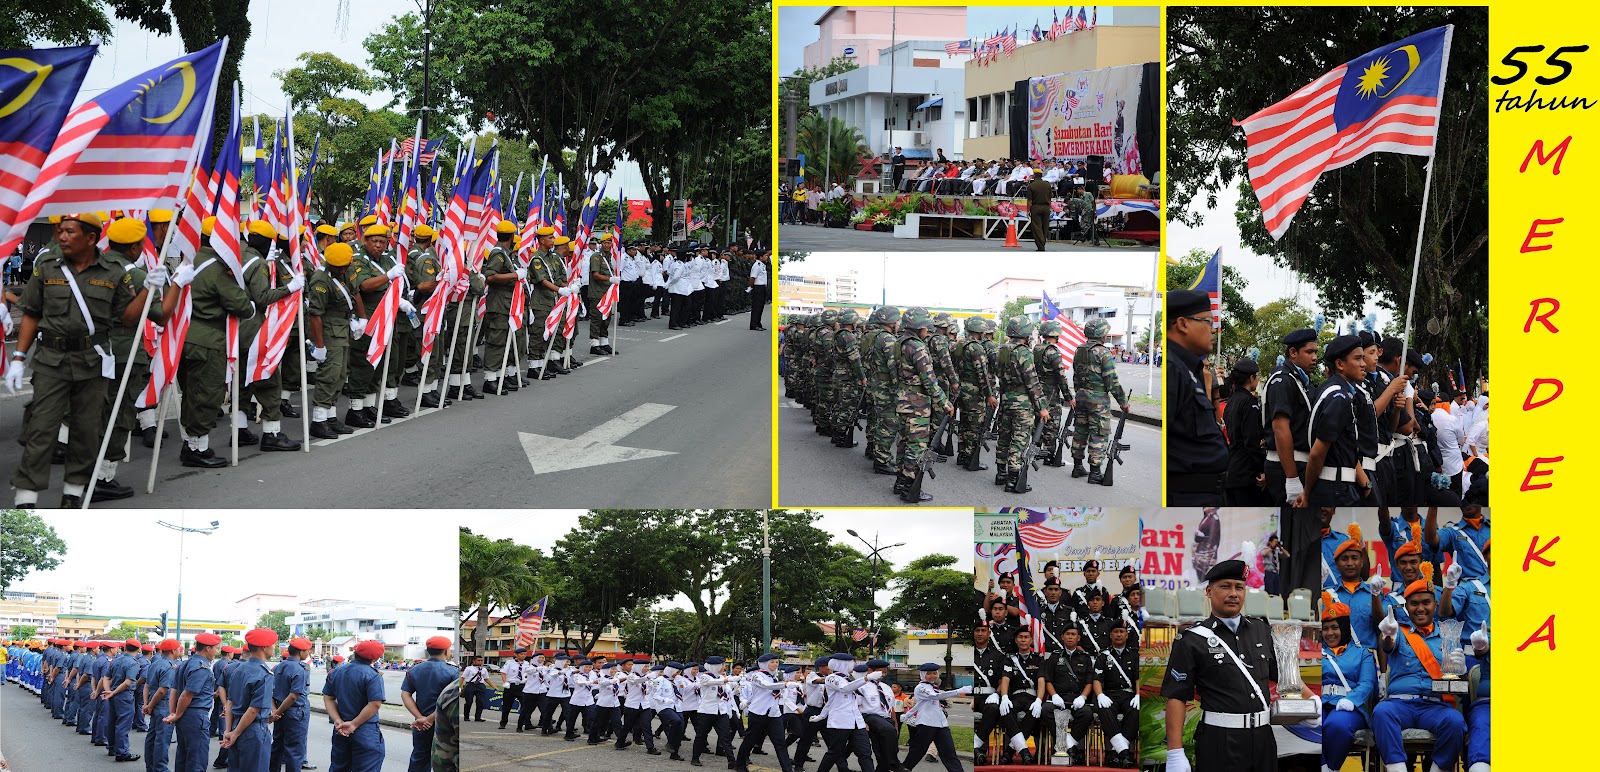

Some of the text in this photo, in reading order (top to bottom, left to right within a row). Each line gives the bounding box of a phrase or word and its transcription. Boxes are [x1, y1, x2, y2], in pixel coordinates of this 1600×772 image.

[1054, 122, 1112, 140] Sambutan Hari
[1054, 140, 1113, 156] KEMERDEKAAN
[1065, 545, 1091, 559] Janji
